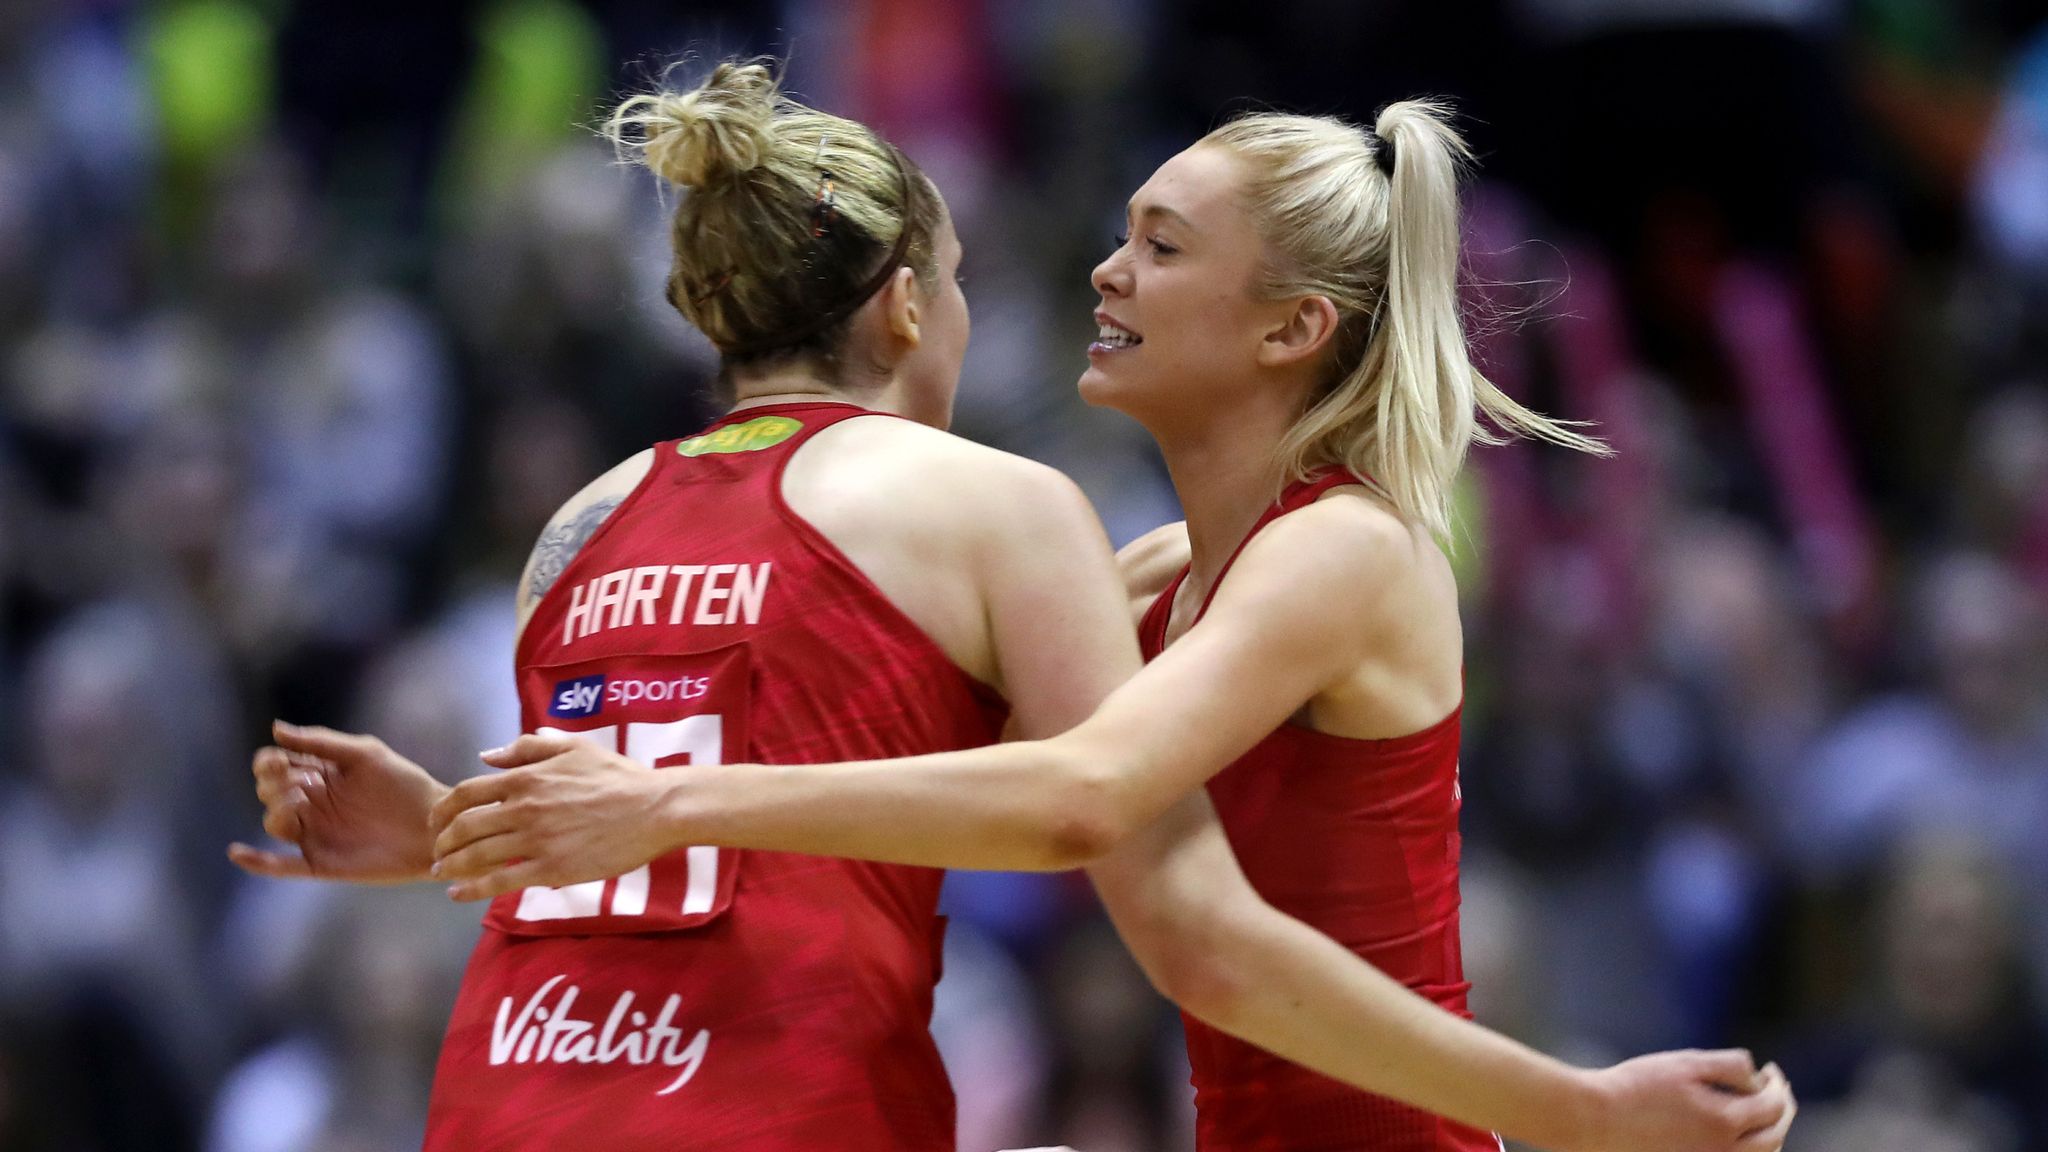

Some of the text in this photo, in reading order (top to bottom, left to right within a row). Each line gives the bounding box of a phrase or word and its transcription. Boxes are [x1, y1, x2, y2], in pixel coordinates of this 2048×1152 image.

[562, 561, 771, 646] HARTEN
[556, 676, 710, 713] sky sports
[489, 974, 711, 1096] Vitality
